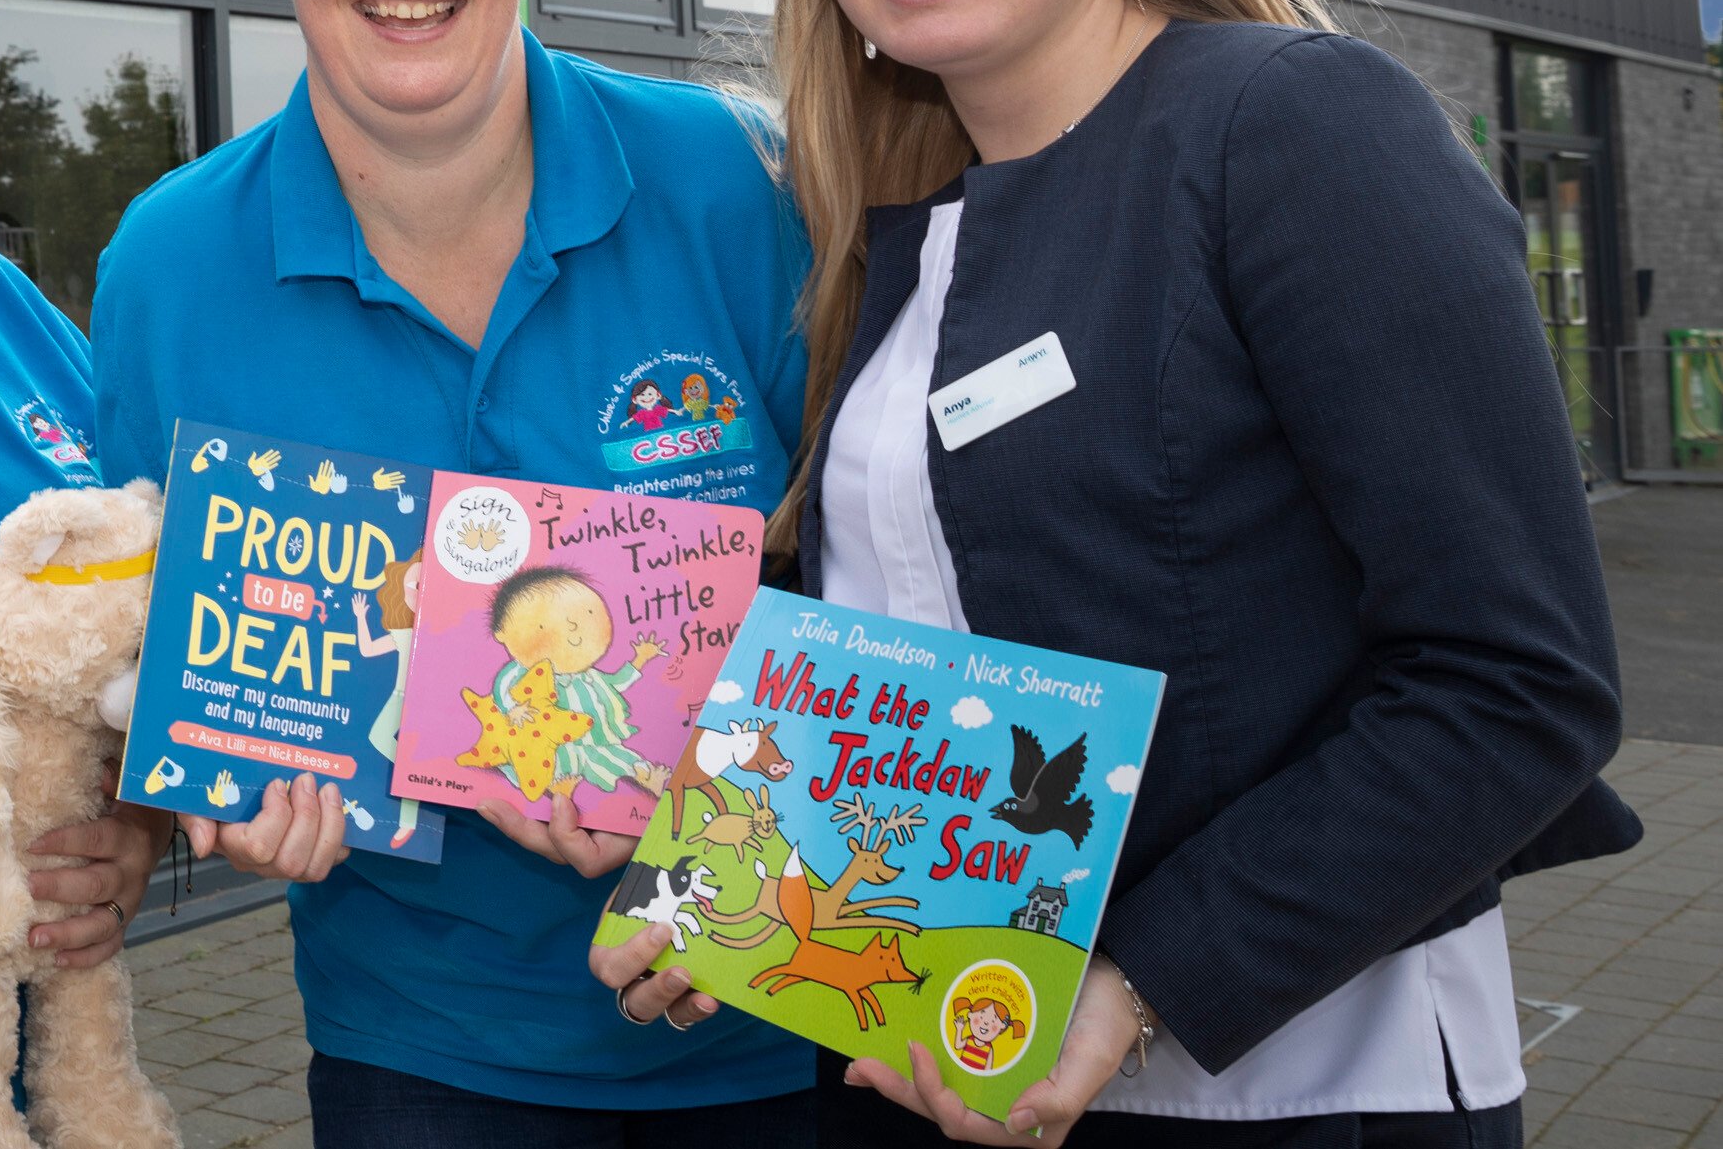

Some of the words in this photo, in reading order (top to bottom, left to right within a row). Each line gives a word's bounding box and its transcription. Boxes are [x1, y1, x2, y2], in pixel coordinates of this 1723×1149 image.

[661, 349, 705, 366] Special
[704, 356, 728, 384] Ears
[943, 396, 972, 417] Anya
[631, 424, 723, 464] CSSEF
[614, 473, 703, 496] Brightening
[705, 468, 724, 483] the
[727, 463, 756, 479] lives
[695, 485, 746, 504] children
[459, 495, 518, 522] Sign
[539, 502, 667, 550] Twinkle,
[202, 494, 396, 590] PROUD
[622, 525, 755, 573] Twinkle,
[253, 580, 274, 606] to
[280, 583, 305, 612] be
[624, 580, 714, 625] Little
[187, 592, 357, 696] DEAF
[680, 620, 740, 656] Star
[791, 612, 840, 645] Julia
[845, 624, 937, 671] Donaldson
[964, 653, 1013, 687] Nick
[1016, 665, 1104, 708] Sharratt
[182, 670, 240, 699] Discover
[244, 687, 266, 708] my
[270, 693, 350, 725] community
[753, 649, 860, 720] What
[869, 683, 930, 730] the
[204, 701, 231, 720] and
[234, 708, 256, 729] my
[260, 710, 323, 741] language
[226, 737, 248, 752] Lilli
[249, 744, 266, 754] and
[268, 747, 292, 763] Nick
[294, 751, 330, 769] Beese
[809, 730, 992, 802] Jackdaw
[408, 774, 443, 787] Child's
[929, 814, 1031, 885] Saw
[967, 984, 989, 996] deaf
[969, 971, 1008, 983] Written
[1009, 979, 1026, 1002] with
